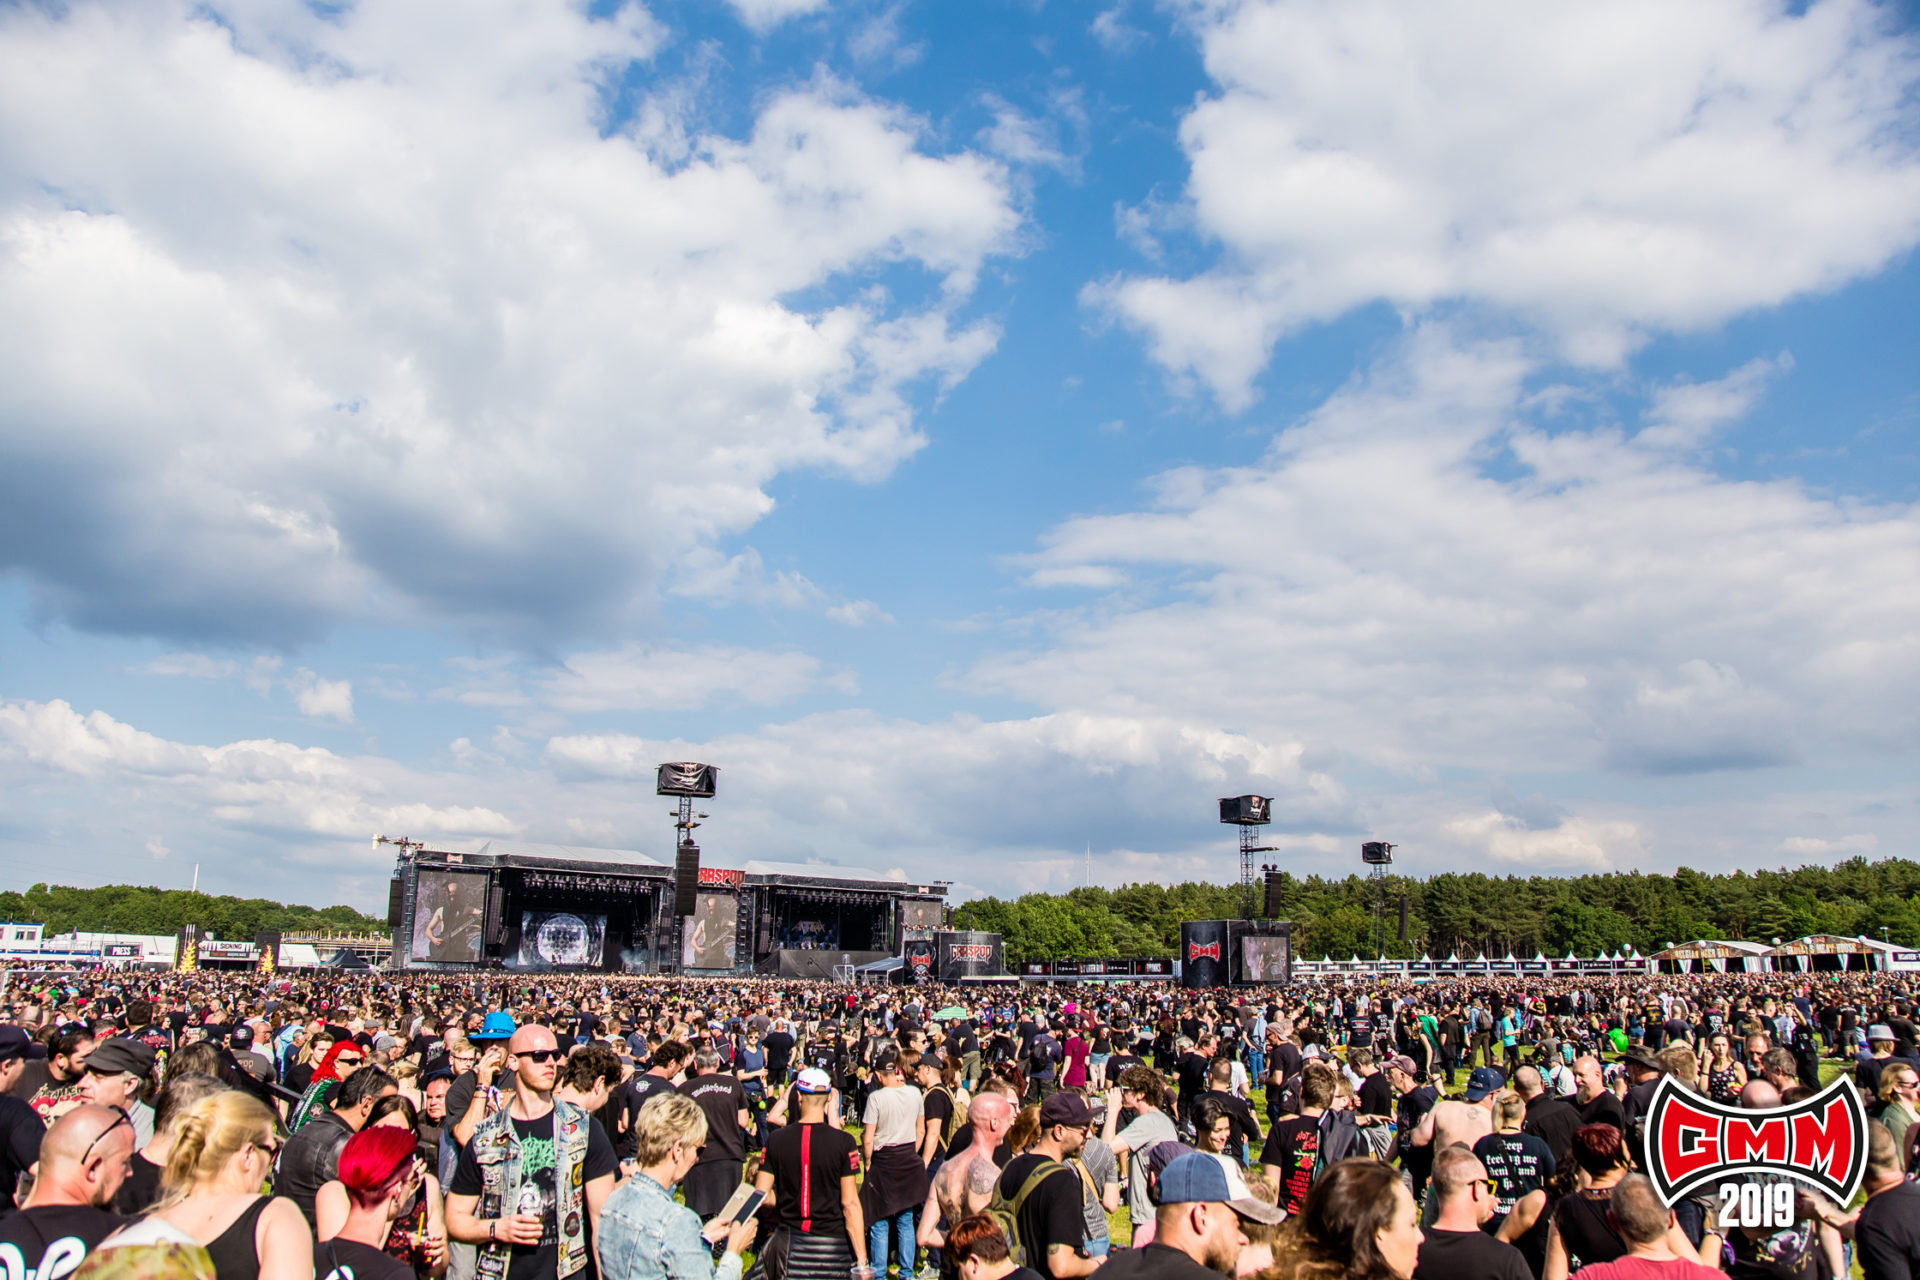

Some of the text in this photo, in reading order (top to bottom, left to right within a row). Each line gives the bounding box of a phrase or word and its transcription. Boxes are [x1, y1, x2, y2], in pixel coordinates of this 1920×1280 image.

[697, 868, 745, 892] RASPOP
[112, 947, 131, 955] PRESS
[949, 944, 992, 965] GRASPOP
[1190, 941, 1220, 961] GMM
